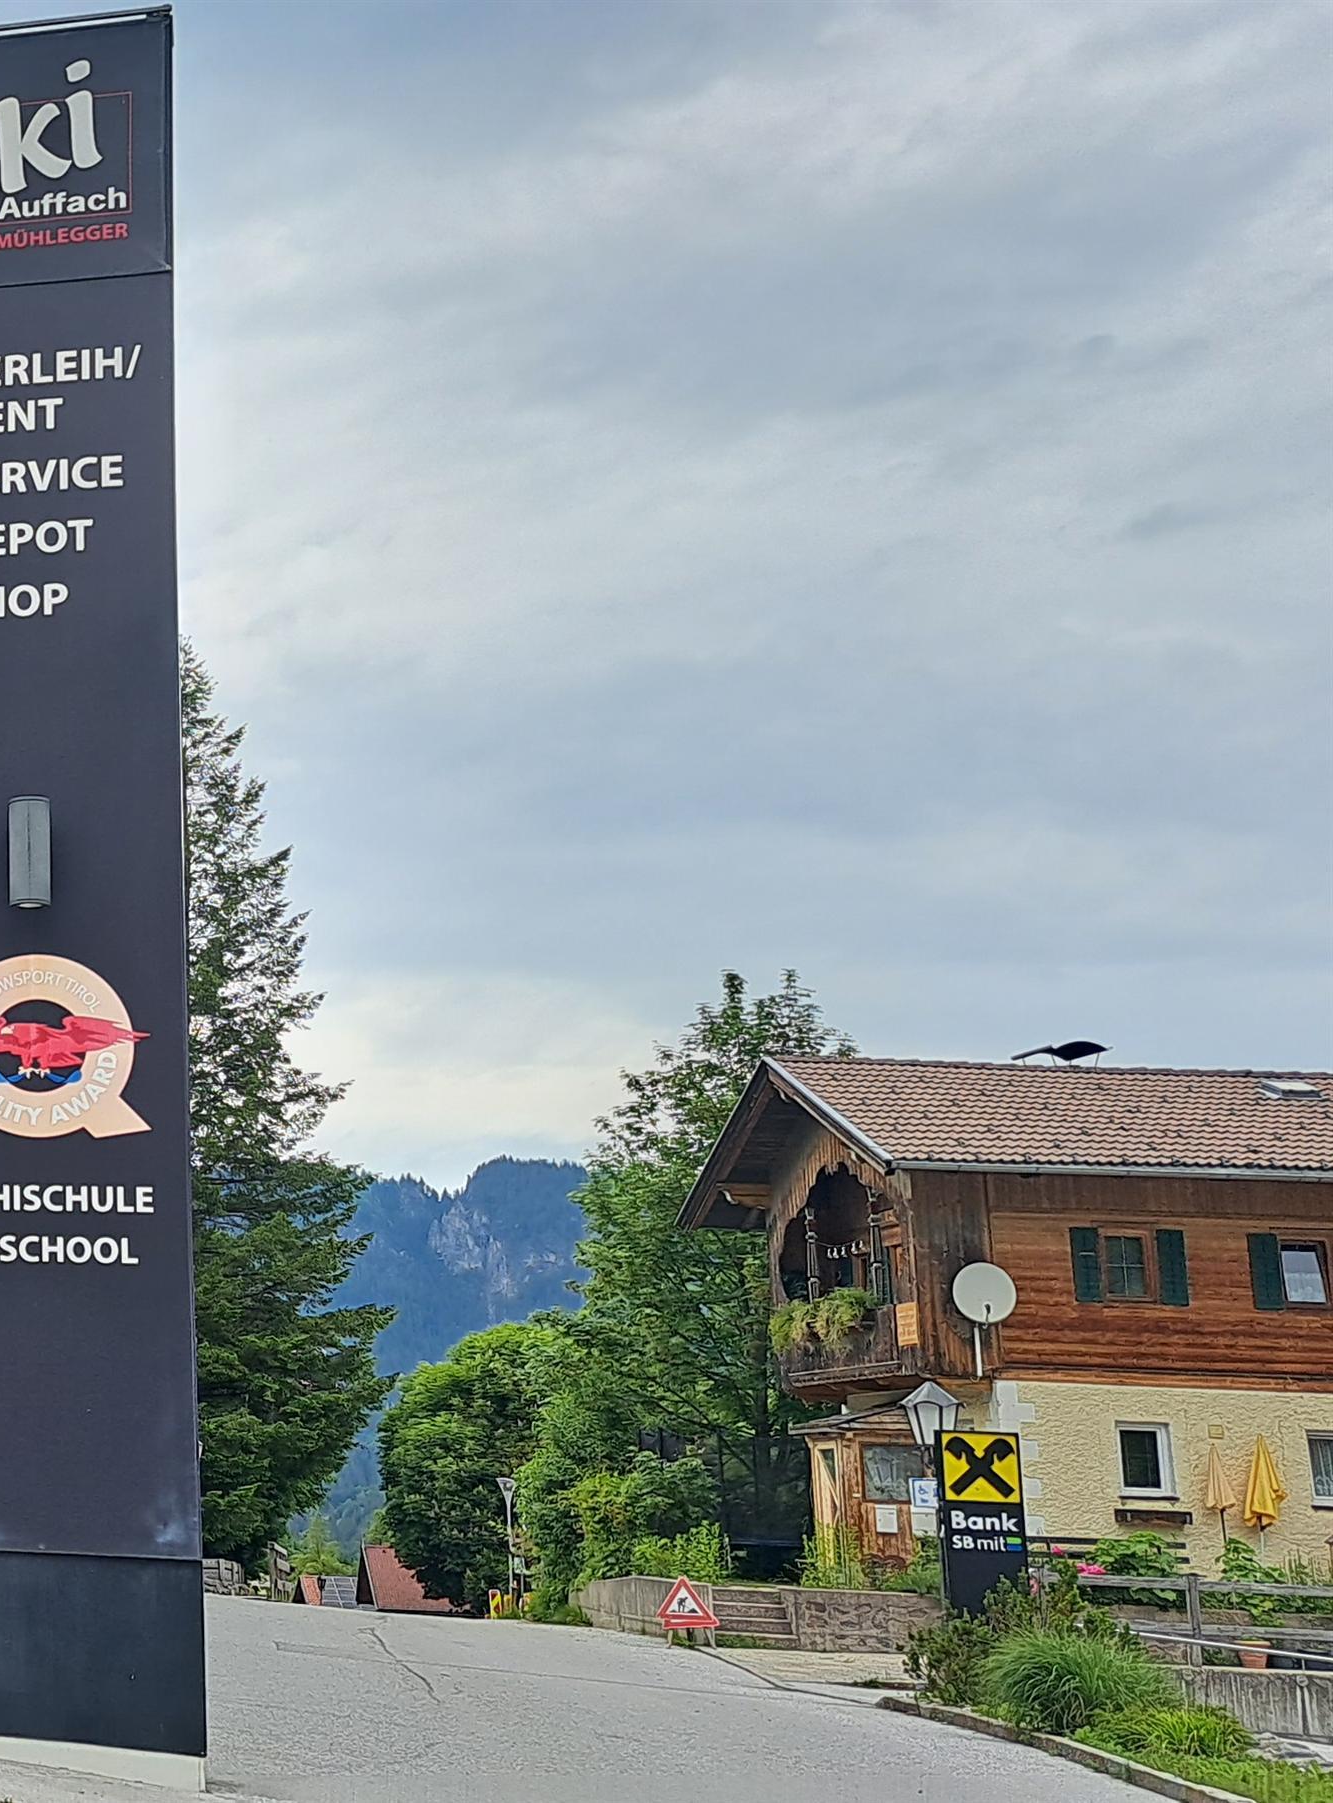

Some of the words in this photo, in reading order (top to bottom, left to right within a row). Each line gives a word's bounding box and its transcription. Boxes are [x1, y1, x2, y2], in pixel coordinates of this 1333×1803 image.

[65, 976, 102, 1013] TIROL
[50, 1050, 119, 1126] AWARD
[950, 1509, 1021, 1533] Bank
[951, 1534, 975, 1550] SB
[976, 1536, 1007, 1553] mit
